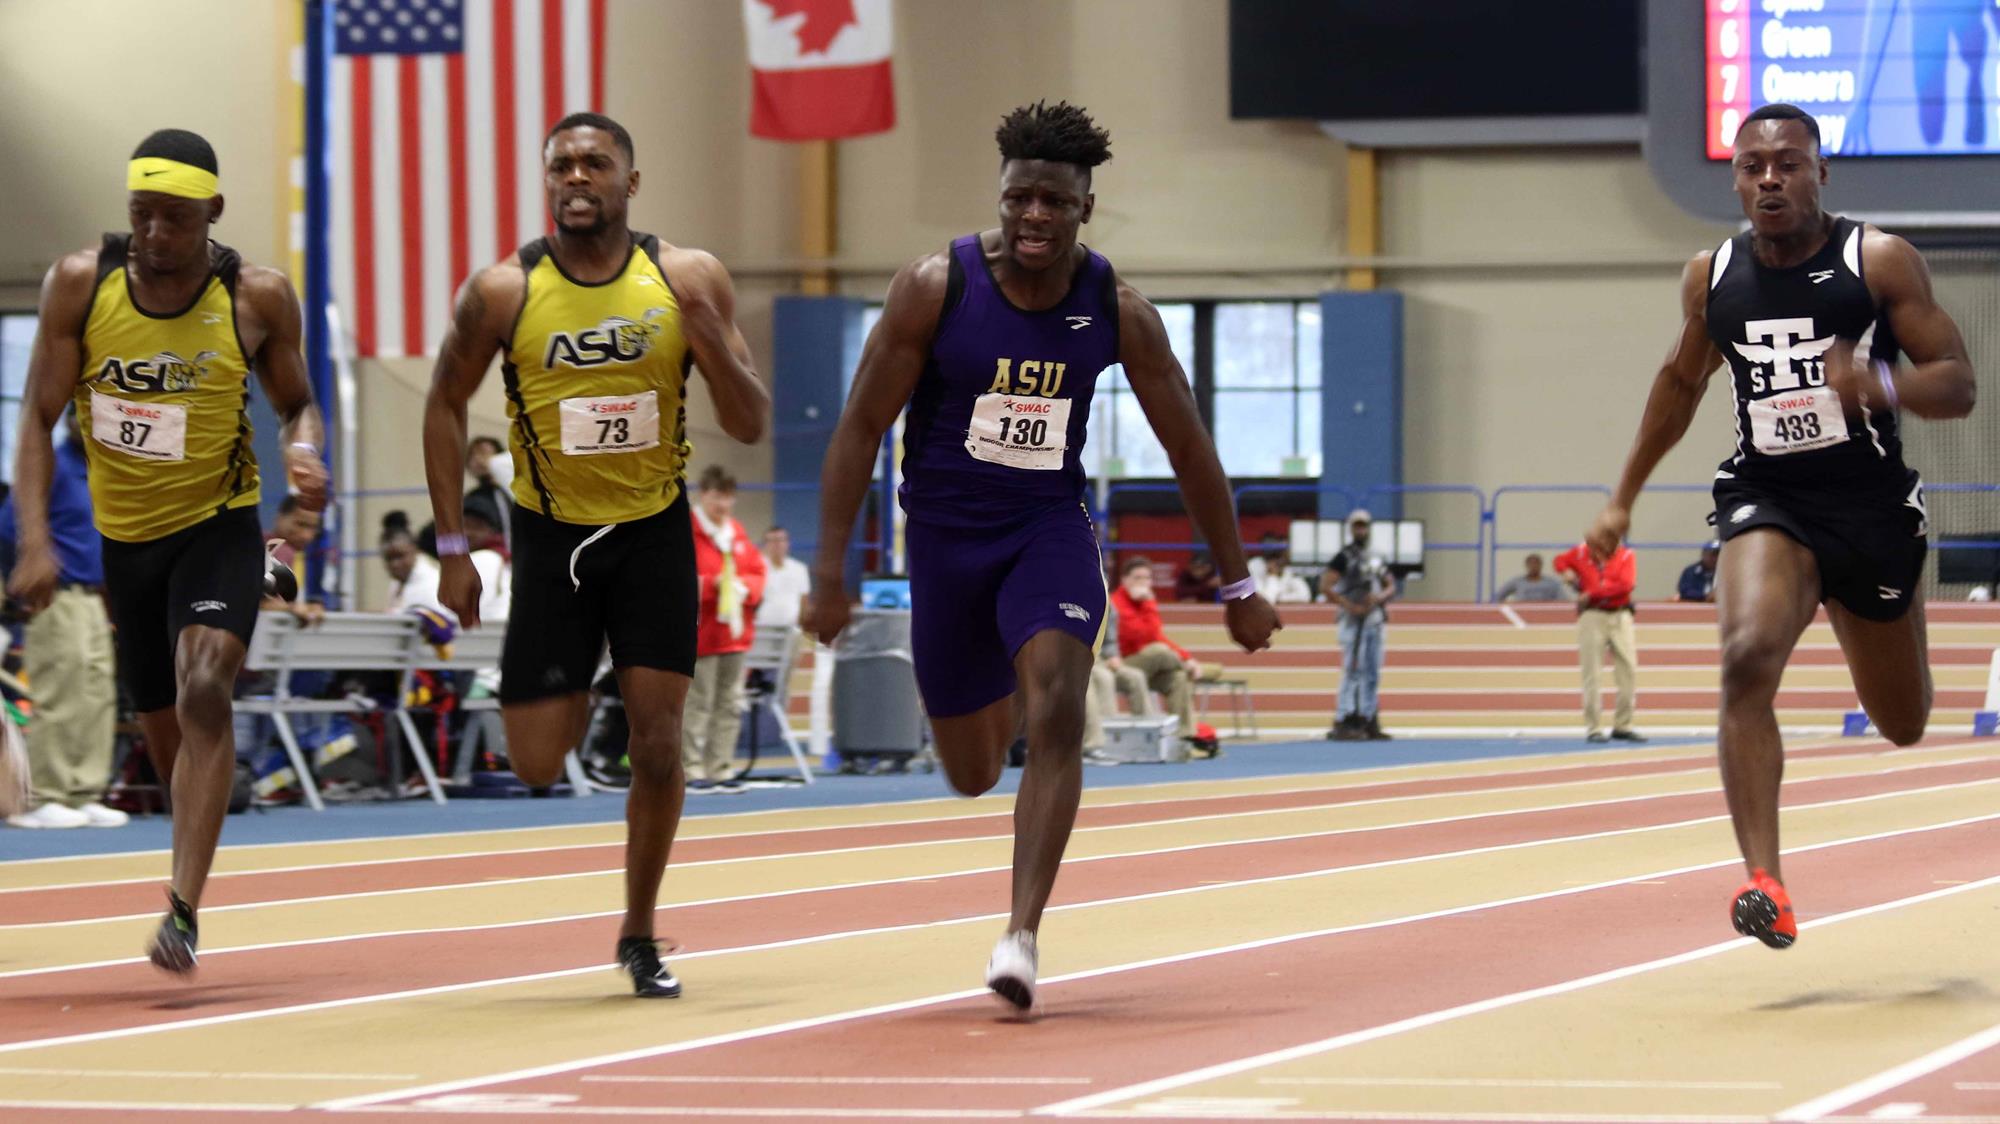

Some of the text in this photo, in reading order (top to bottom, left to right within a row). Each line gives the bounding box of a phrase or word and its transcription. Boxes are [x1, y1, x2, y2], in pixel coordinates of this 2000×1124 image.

[1720, 19, 1740, 58] 6
[1720, 64, 1740, 103] 7
[1721, 109, 1740, 147] 8
[987, 357, 1066, 398] ASU
[600, 401, 638, 414] SWAC
[1015, 403, 1052, 414] SWAC
[1780, 396, 1815, 410] SWAC
[120, 420, 153, 447] 87
[595, 418, 630, 444] 73
[1000, 416, 1048, 447] 130
[1774, 412, 1822, 443] 433
